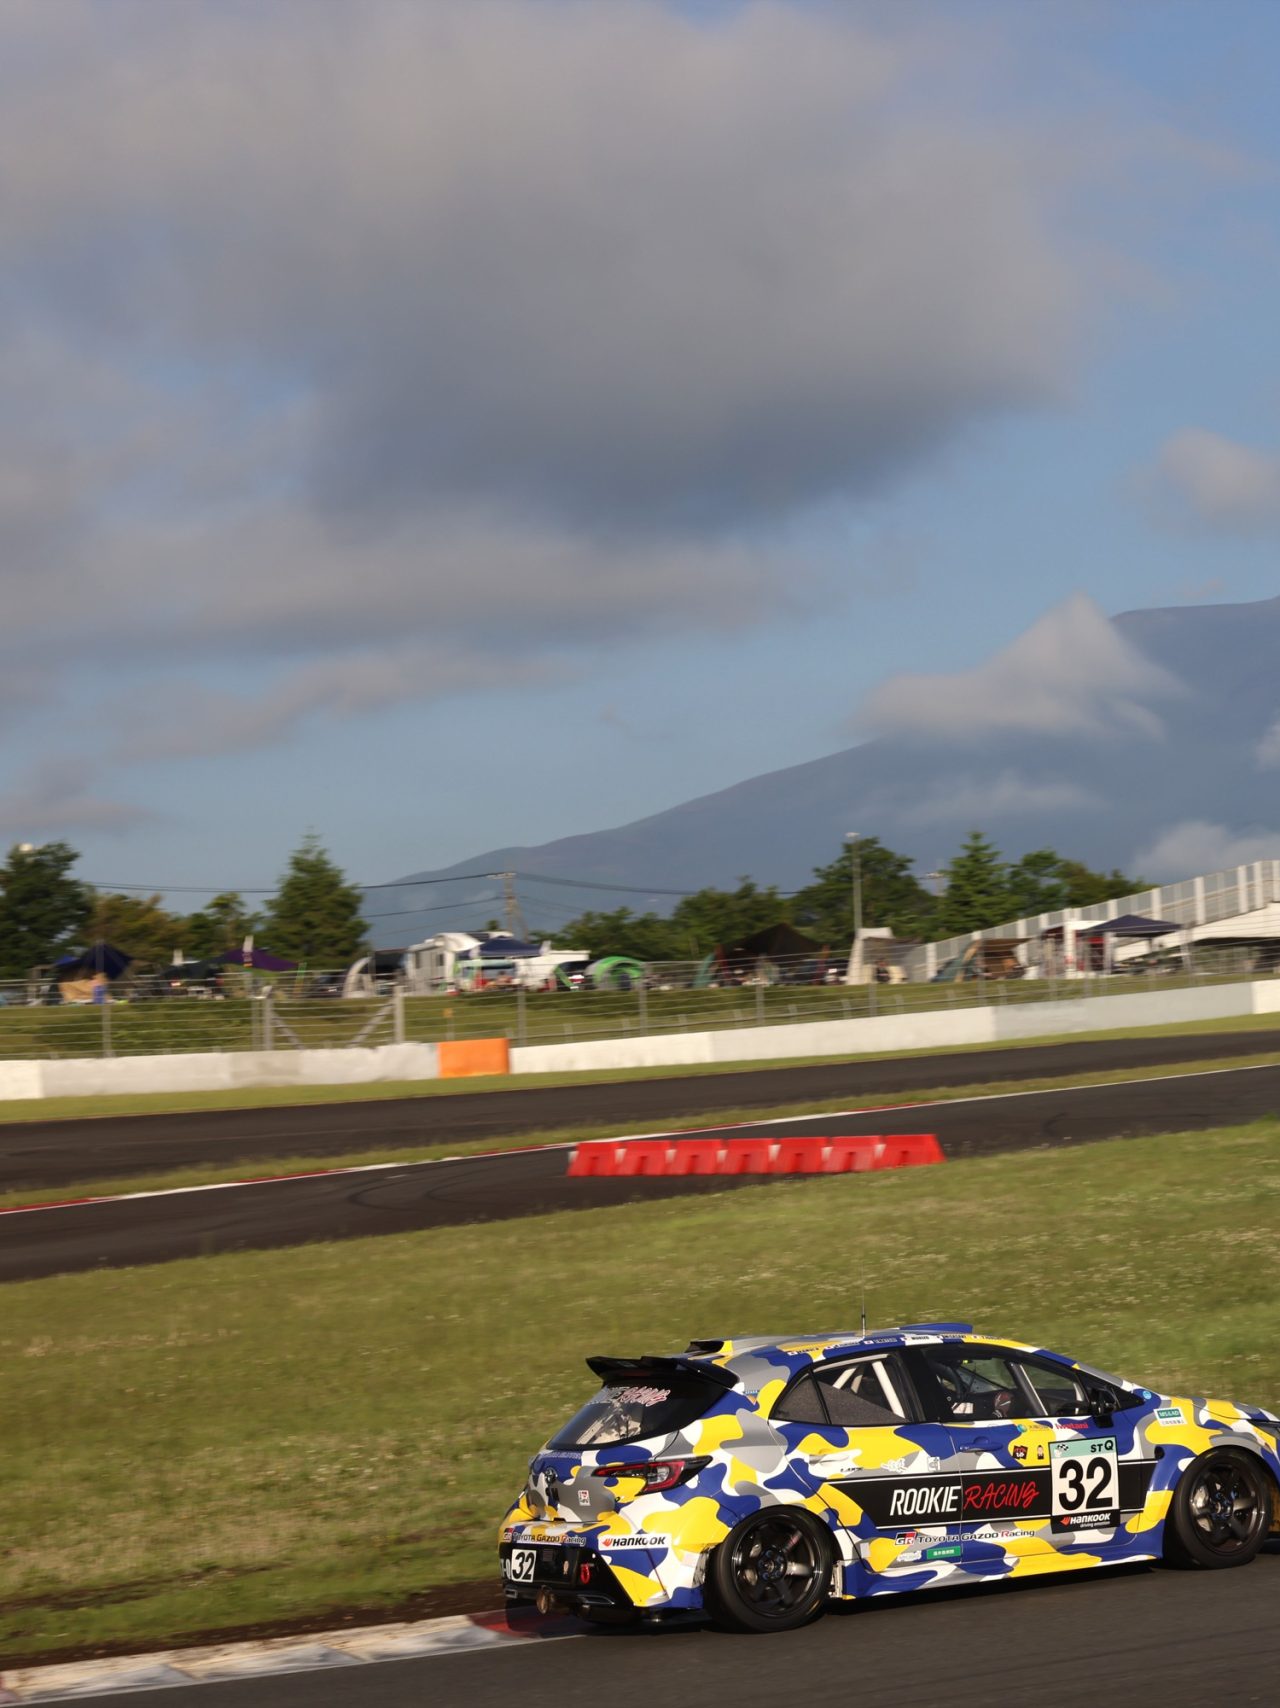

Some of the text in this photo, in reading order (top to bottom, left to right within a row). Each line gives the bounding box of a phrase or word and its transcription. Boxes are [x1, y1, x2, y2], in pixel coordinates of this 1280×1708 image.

[890, 1481, 1039, 1516] ROOKIE RACING
[1058, 1457, 1113, 1511] 32
[536, 1533, 560, 1543] GAZOO
[560, 1533, 586, 1547] Racing
[917, 1535, 960, 1544] TOYOTA
[960, 1532, 999, 1542] GAZOO
[1000, 1529, 1035, 1539] Racing
[512, 1551, 535, 1581] 32
